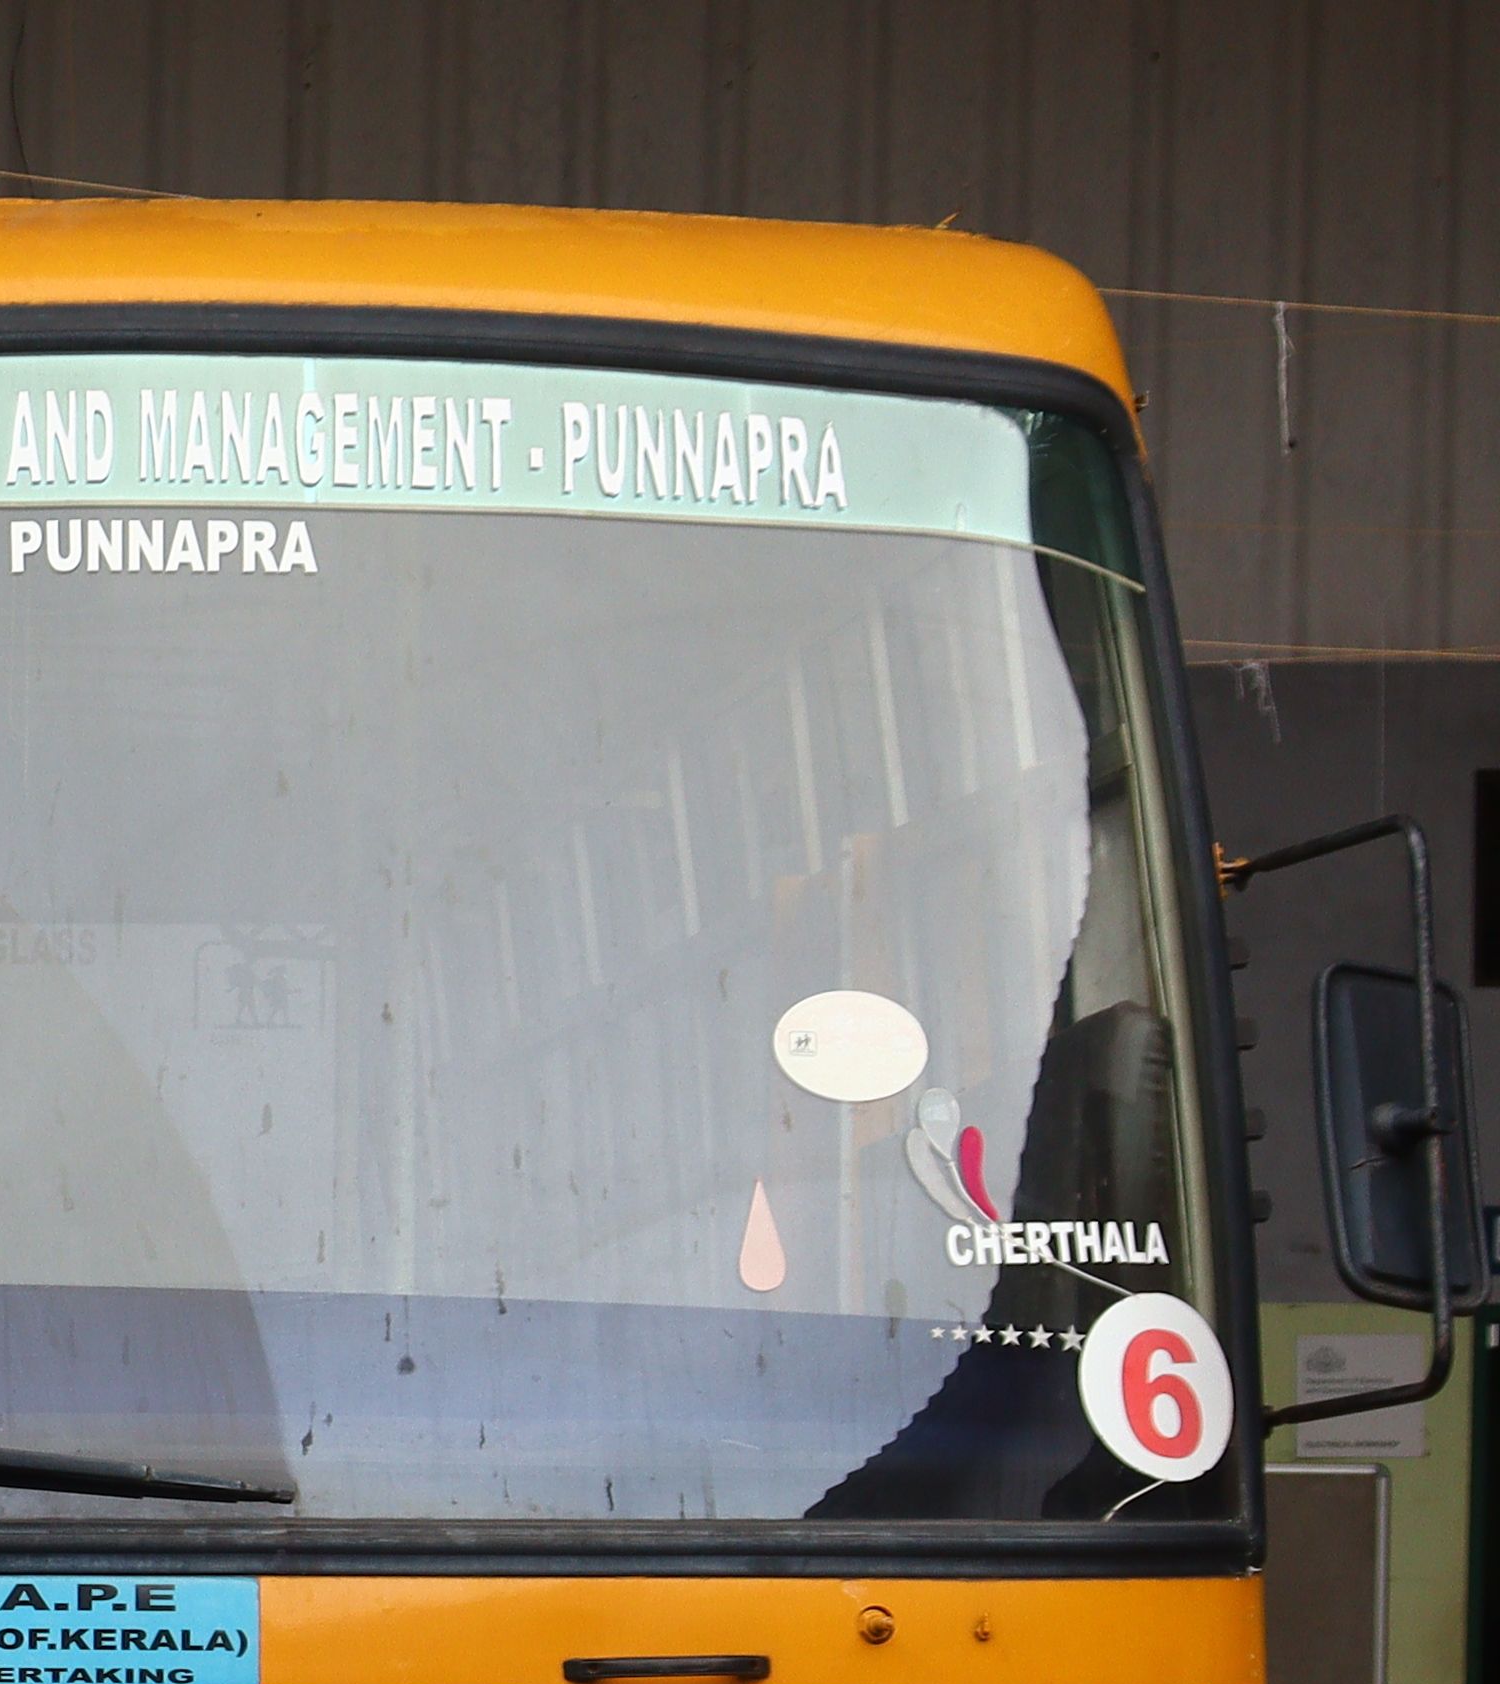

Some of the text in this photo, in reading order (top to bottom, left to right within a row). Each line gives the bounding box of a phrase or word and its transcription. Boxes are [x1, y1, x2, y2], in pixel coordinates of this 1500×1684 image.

[6, 389, 114, 486] AND
[137, 389, 512, 492] MANAGEMENT
[562, 402, 848, 510] PUNNAPRA
[9, 518, 318, 574] PUNNAPRA
[946, 1219, 1170, 1265] CHERTHALA
[1121, 1329, 1204, 1459] 6
